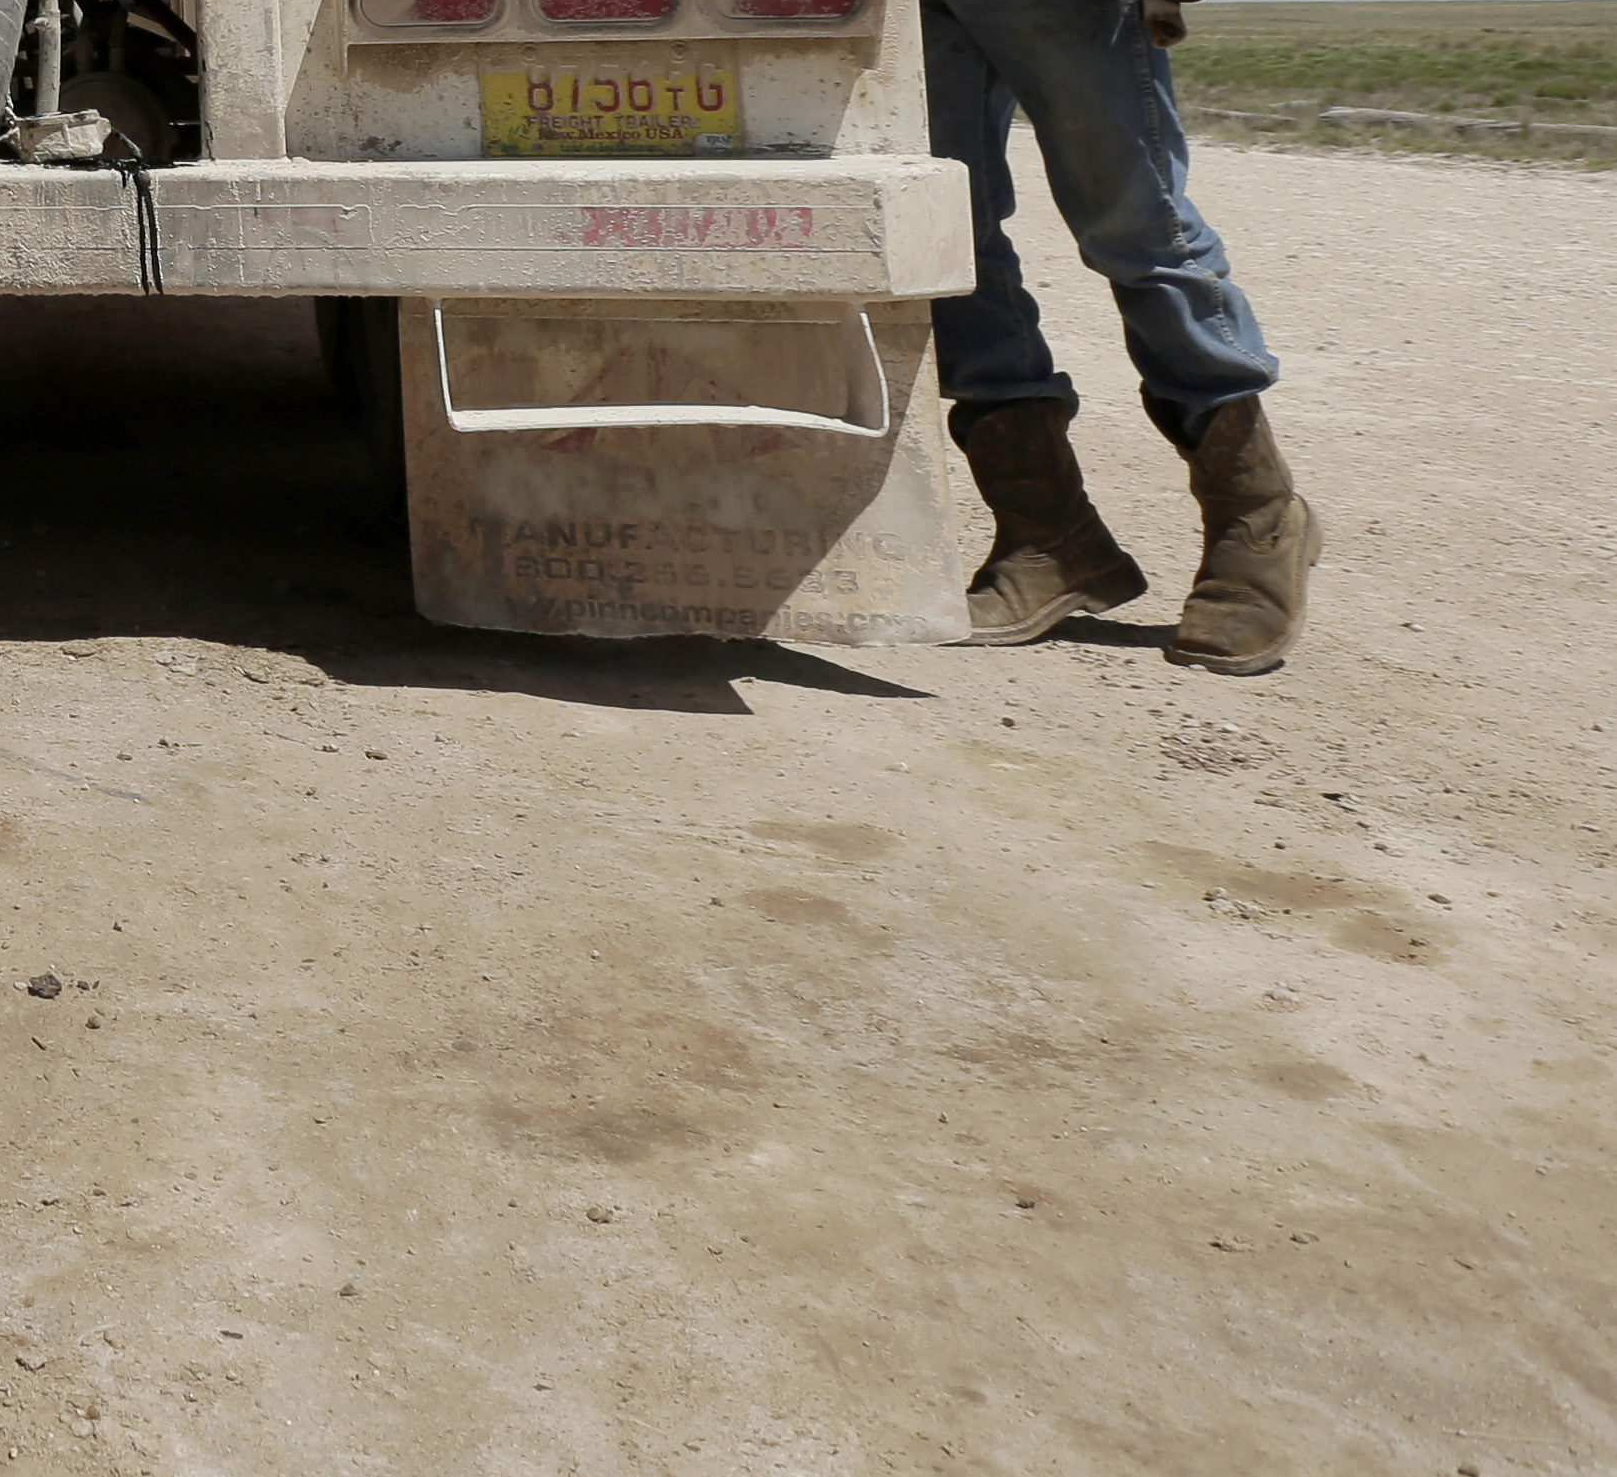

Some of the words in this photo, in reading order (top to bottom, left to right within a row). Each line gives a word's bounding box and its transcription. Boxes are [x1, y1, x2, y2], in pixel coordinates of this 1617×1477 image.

[526, 115, 605, 128] FREIGHT
[576, 128, 641, 140] Mexico
[645, 128, 685, 140] USA
